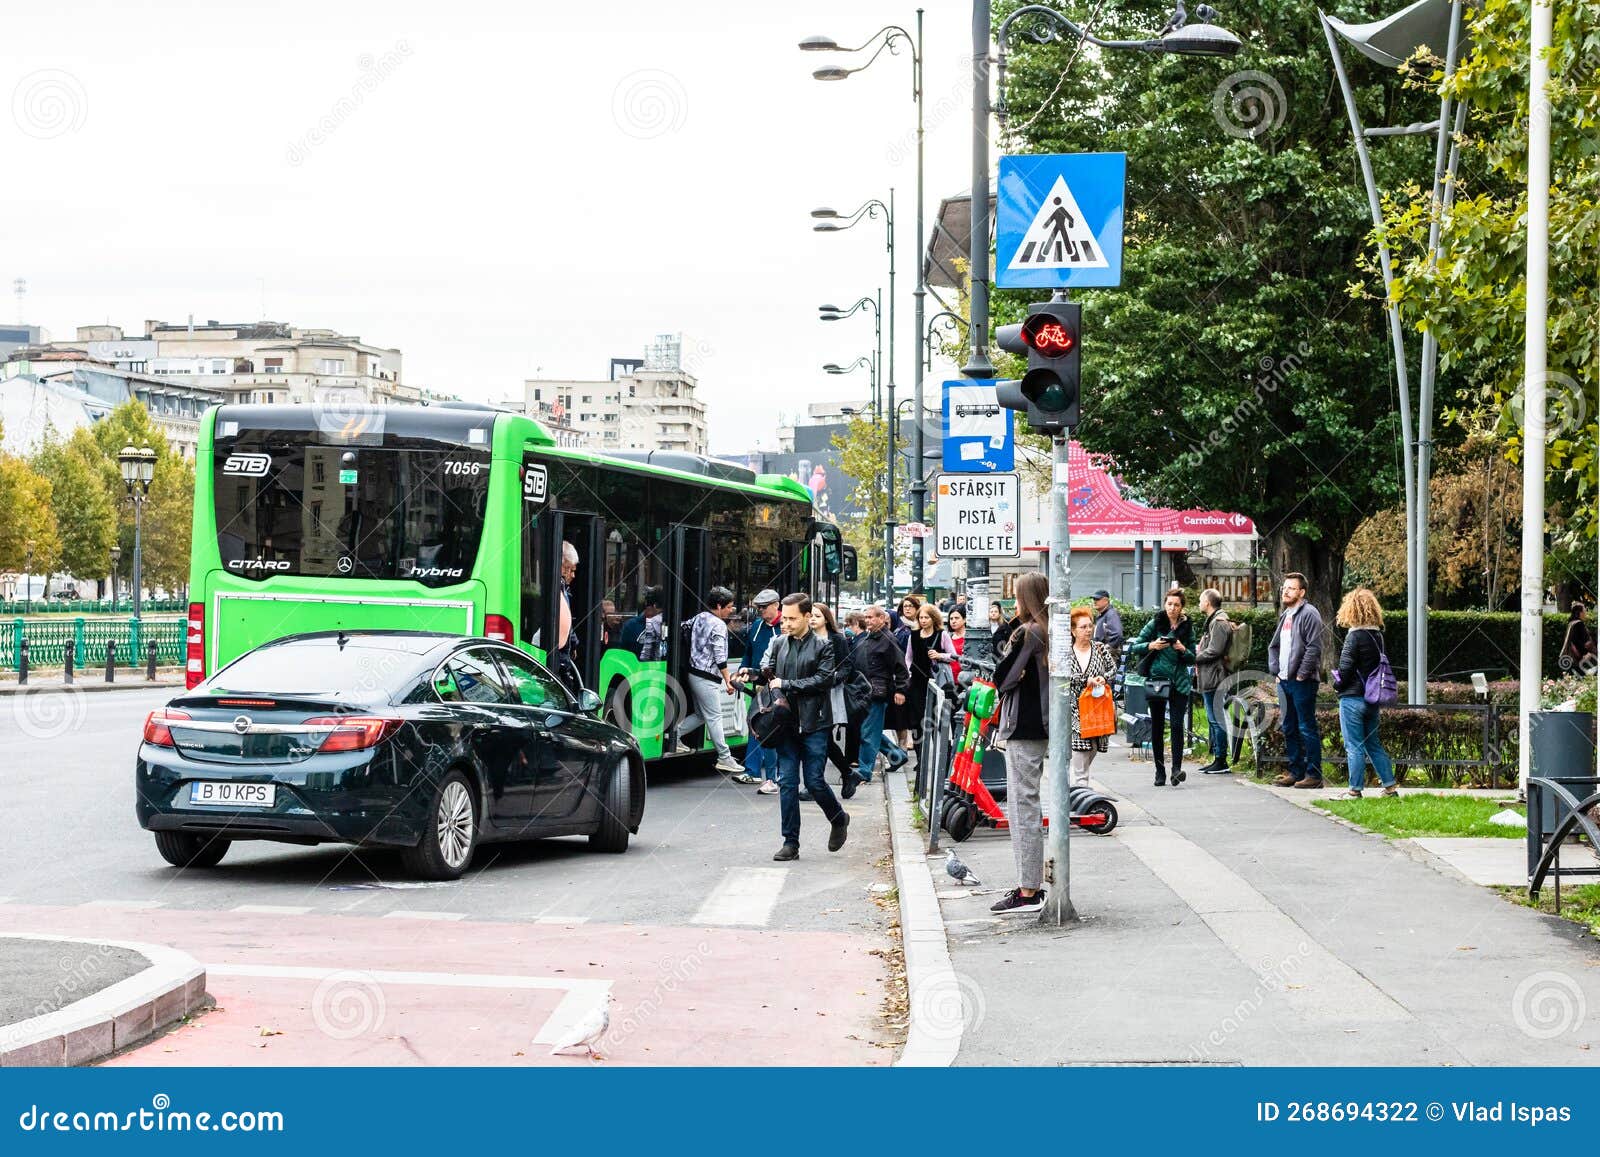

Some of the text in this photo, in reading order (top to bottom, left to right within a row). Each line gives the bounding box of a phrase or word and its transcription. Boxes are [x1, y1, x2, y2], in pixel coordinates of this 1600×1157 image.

[223, 456, 267, 472] STB
[444, 461, 480, 475] 7056
[524, 469, 545, 495] STB
[950, 479, 1006, 498] SFÂRȘIT
[959, 507, 997, 524] PISTĂ
[1183, 516, 1226, 525] Carrefour
[942, 536, 1013, 550] BICICLETE
[410, 566, 464, 578] hybrid
[203, 784, 267, 800] B 10 KPS
